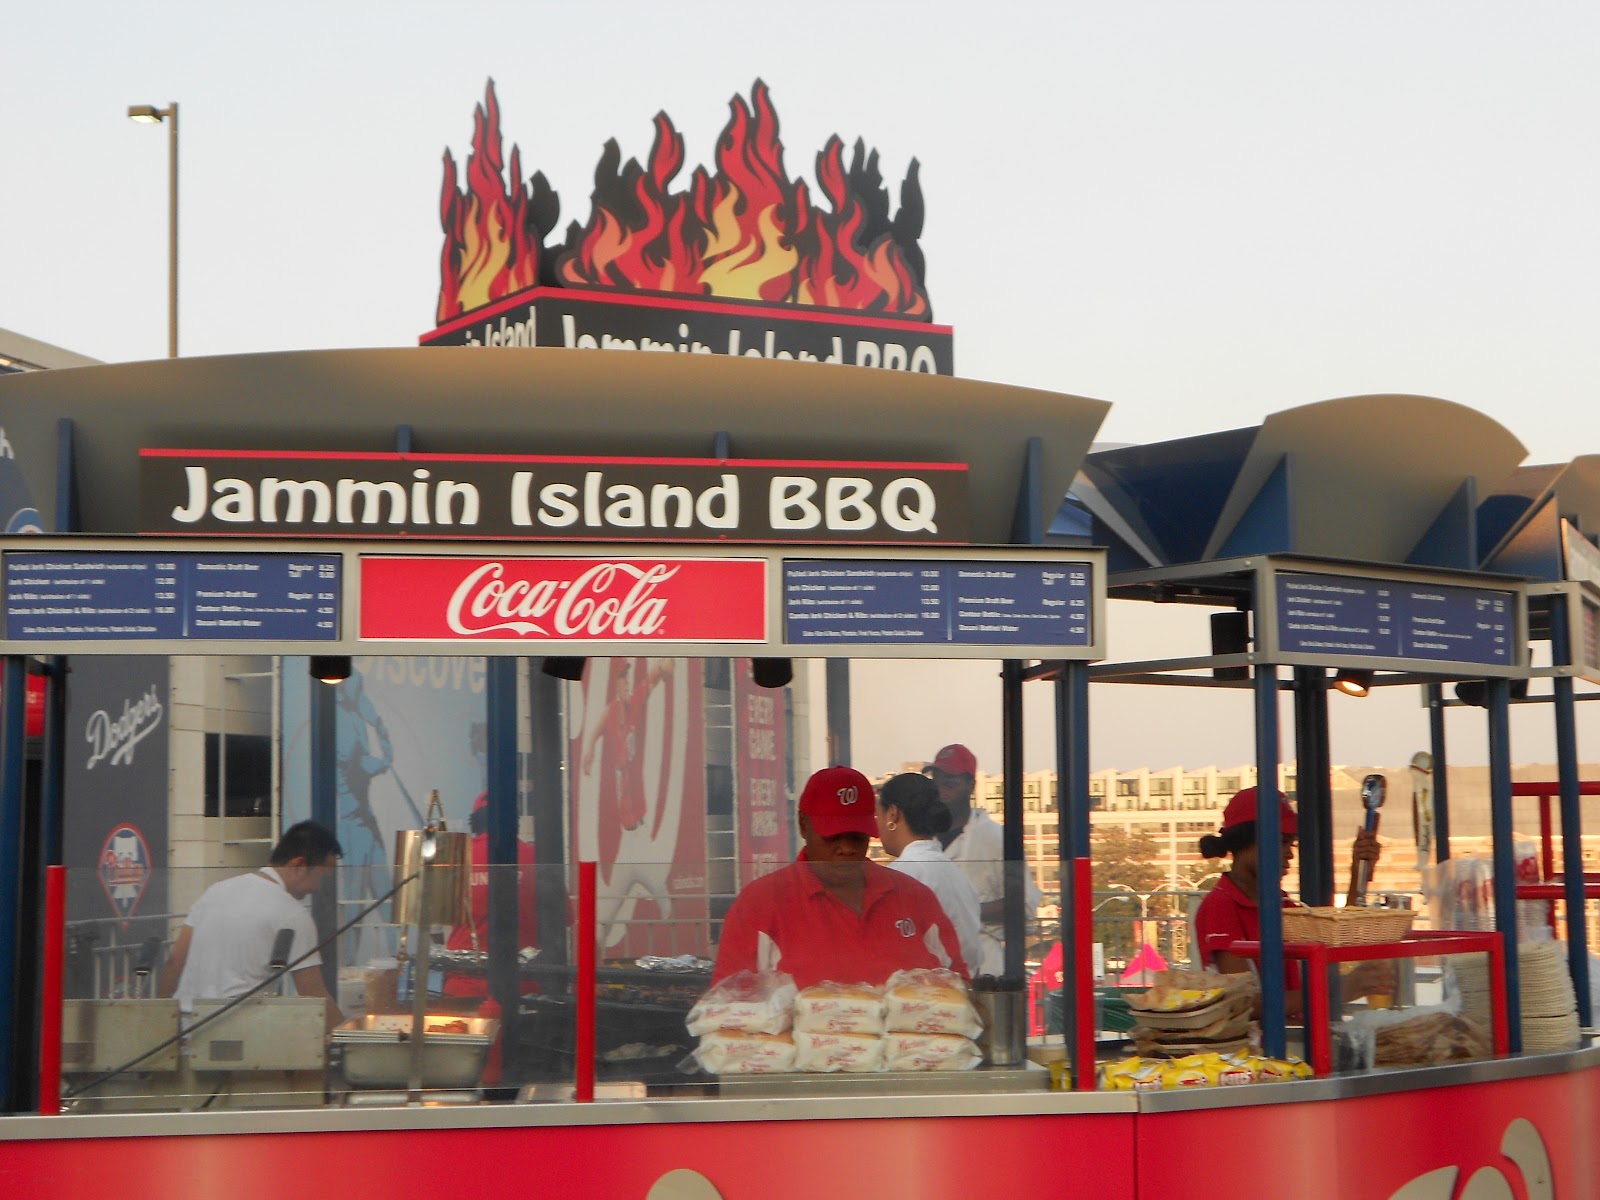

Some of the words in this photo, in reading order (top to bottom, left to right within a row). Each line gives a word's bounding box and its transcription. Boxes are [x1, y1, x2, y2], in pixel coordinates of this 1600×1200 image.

[171, 466, 480, 525] Jammin
[511, 471, 740, 529] Island
[769, 476, 938, 534] BBQ
[446, 562, 681, 636] Coca-Cola
[86, 684, 163, 770] Dodgers
[836, 785, 859, 806] W
[895, 917, 916, 938] W
